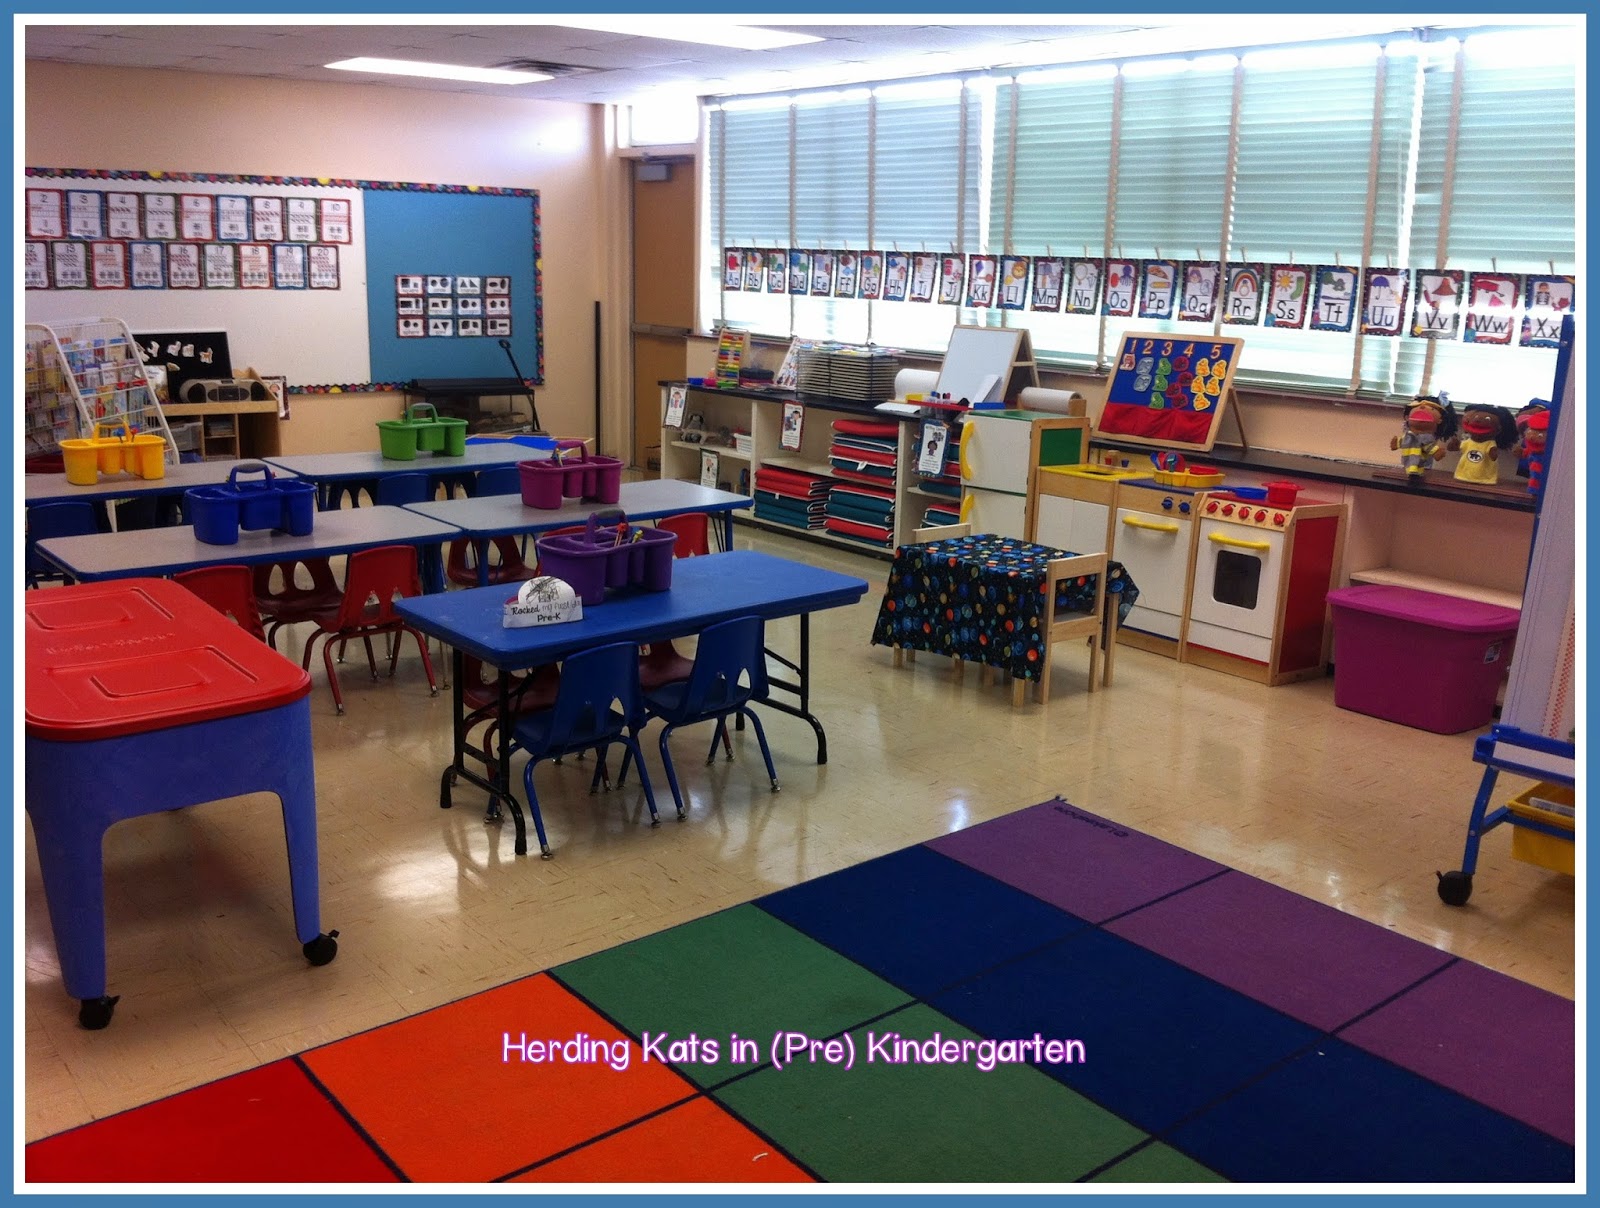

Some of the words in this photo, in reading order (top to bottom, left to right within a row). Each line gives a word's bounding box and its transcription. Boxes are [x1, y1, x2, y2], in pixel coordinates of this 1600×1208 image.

[80, 195, 88, 204] 3
[156, 197, 163, 206] 5
[229, 199, 236, 208] 7
[331, 203, 340, 211] 10
[216, 246, 224, 254] 17
[317, 248, 329, 256] 20
[748, 273, 759, 287] Bb
[771, 274, 782, 288] Cc
[792, 274, 805, 289] Dd
[816, 275, 828, 290] Ee
[840, 277, 851, 292] Ff
[865, 277, 877, 295] Gg
[889, 280, 901, 295] Hh
[945, 282, 957, 300] Jj
[973, 284, 987, 301] Kk
[1006, 286, 1019, 302] Ll
[1037, 288, 1057, 305] Mm
[1074, 289, 1090, 307] Nn
[1110, 291, 1128, 308] Oo
[1147, 292, 1165, 314] Pp
[1188, 295, 1209, 317] Qq
[1232, 298, 1252, 316] Rr
[1275, 300, 1296, 320] Ss
[1324, 302, 1343, 323] Tt
[1372, 306, 1394, 326] Uu
[1426, 309, 1448, 329] Vv
[1474, 314, 1508, 332] Ww
[1535, 318, 1560, 338] Xx
[1131, 339, 1138, 353] 1
[1142, 340, 1154, 354] 2
[1162, 341, 1173, 356] 3
[1183, 343, 1194, 358] 4
[1210, 345, 1222, 359] 5
[511, 605, 540, 616] Rocked
[542, 604, 553, 613] my
[537, 612, 561, 622] Pre-K
